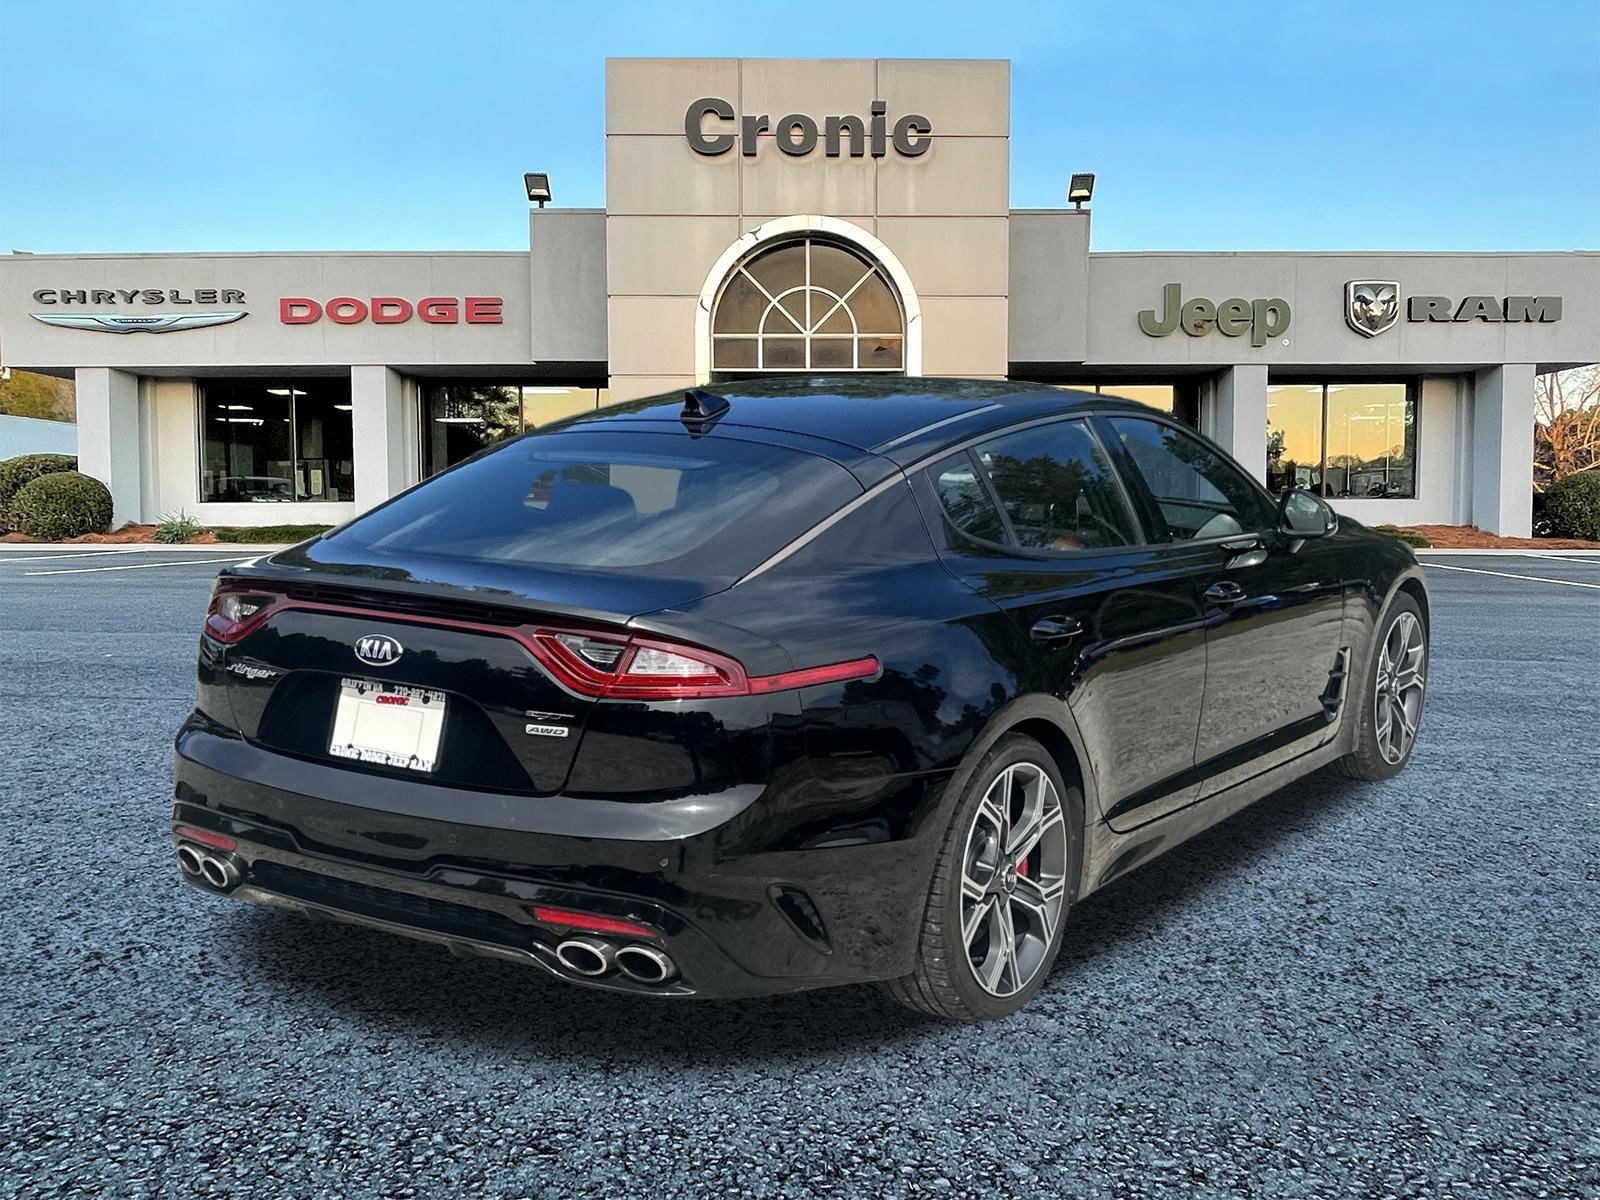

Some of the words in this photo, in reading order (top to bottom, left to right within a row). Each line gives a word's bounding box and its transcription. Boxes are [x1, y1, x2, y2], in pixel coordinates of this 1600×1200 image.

[685, 97, 932, 157] Cronic
[32, 288, 247, 304] CHRYSLER
[1407, 296, 1563, 322] RAM
[280, 297, 503, 324] DODGE
[1138, 283, 1291, 347] Jeep
[360, 639, 393, 660] KIA
[528, 727, 565, 735] AWD
